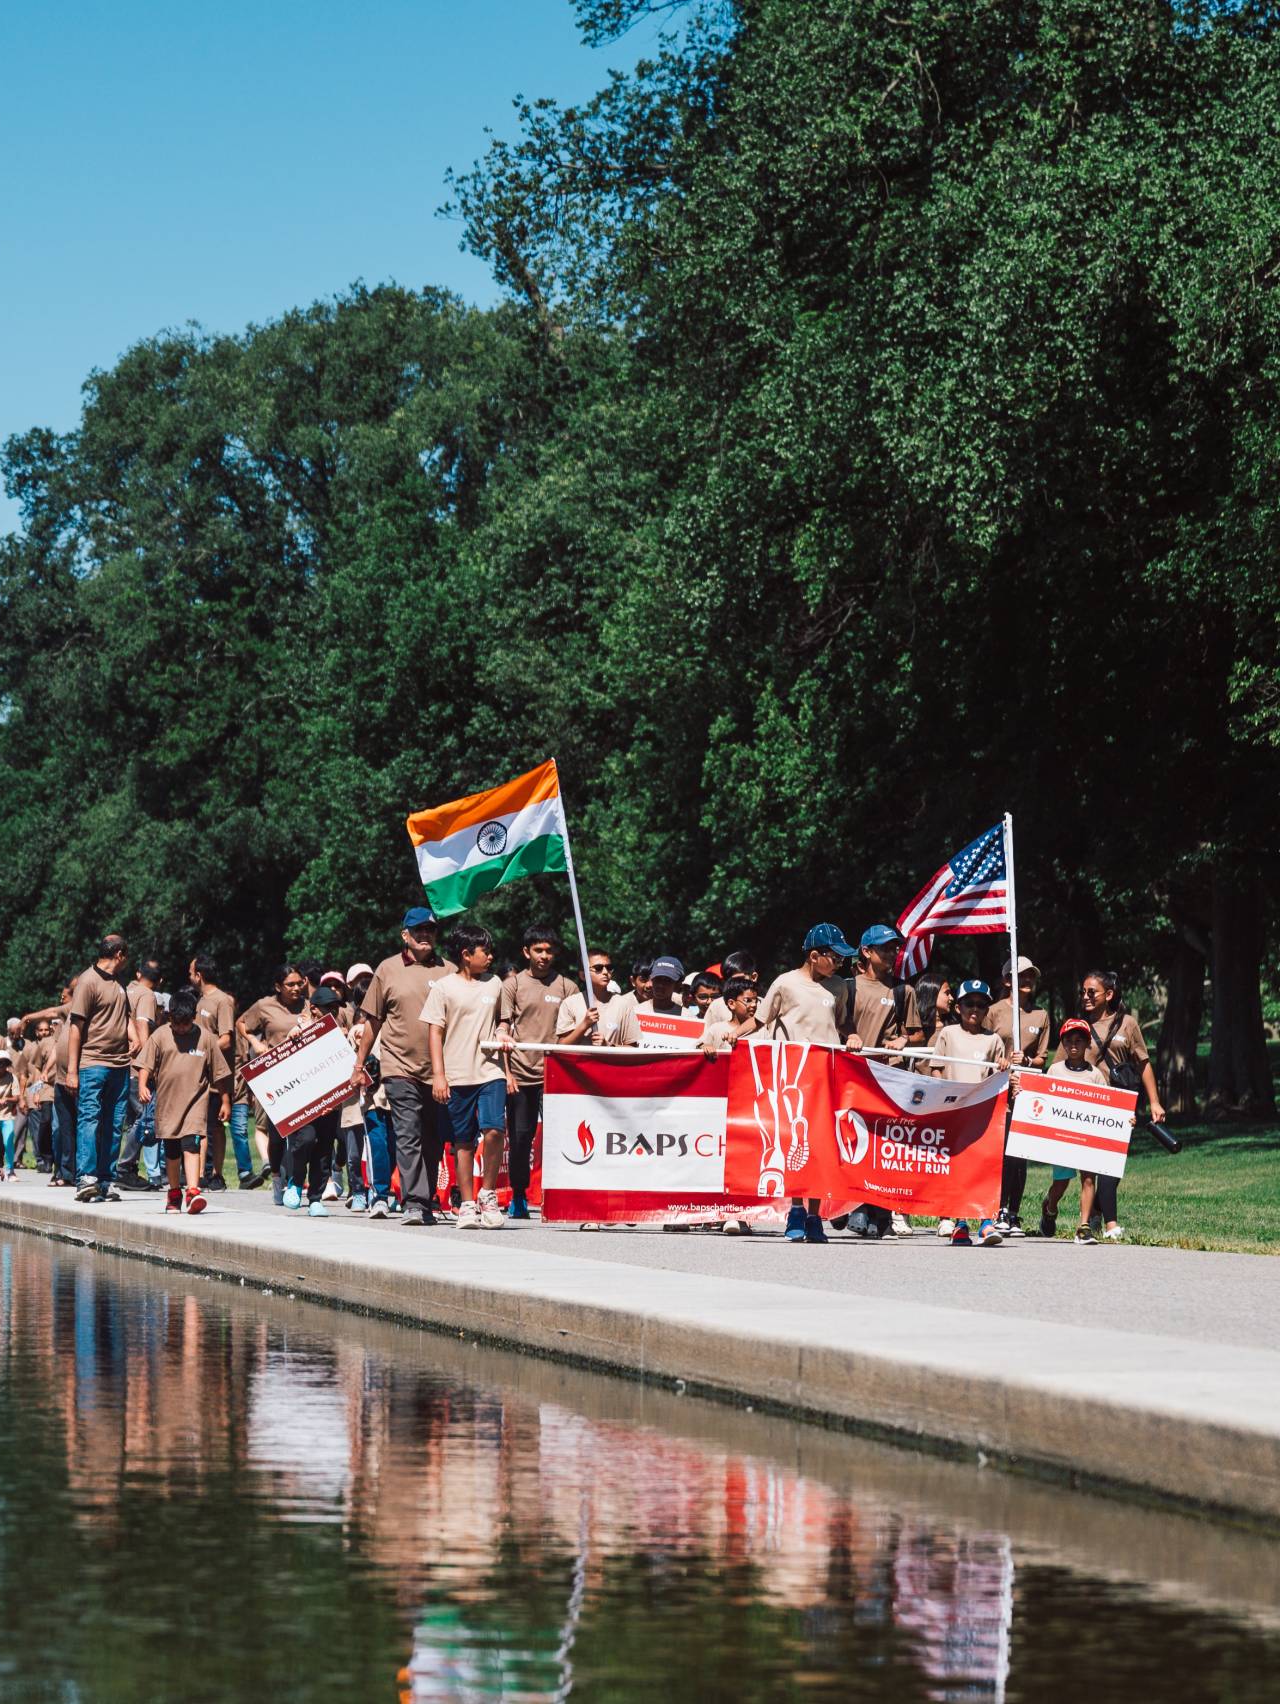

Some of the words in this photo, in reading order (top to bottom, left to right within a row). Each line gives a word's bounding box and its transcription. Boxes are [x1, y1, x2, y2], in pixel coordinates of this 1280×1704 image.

[249, 1054, 272, 1070] Building
[277, 1041, 293, 1053] Better
[264, 1059, 277, 1068] One
[277, 1050, 290, 1061] Step
[303, 1034, 317, 1044] Time
[1051, 1106, 1124, 1129] WALKATHON
[606, 1132, 688, 1157] BAPS
[881, 1125, 918, 1142] JOY
[921, 1128, 945, 1145] OF
[881, 1141, 951, 1164] OTHERS
[881, 1159, 913, 1172] WALK
[925, 1163, 951, 1175] RUN
[667, 1203, 760, 1213] www.bapscharities.o
